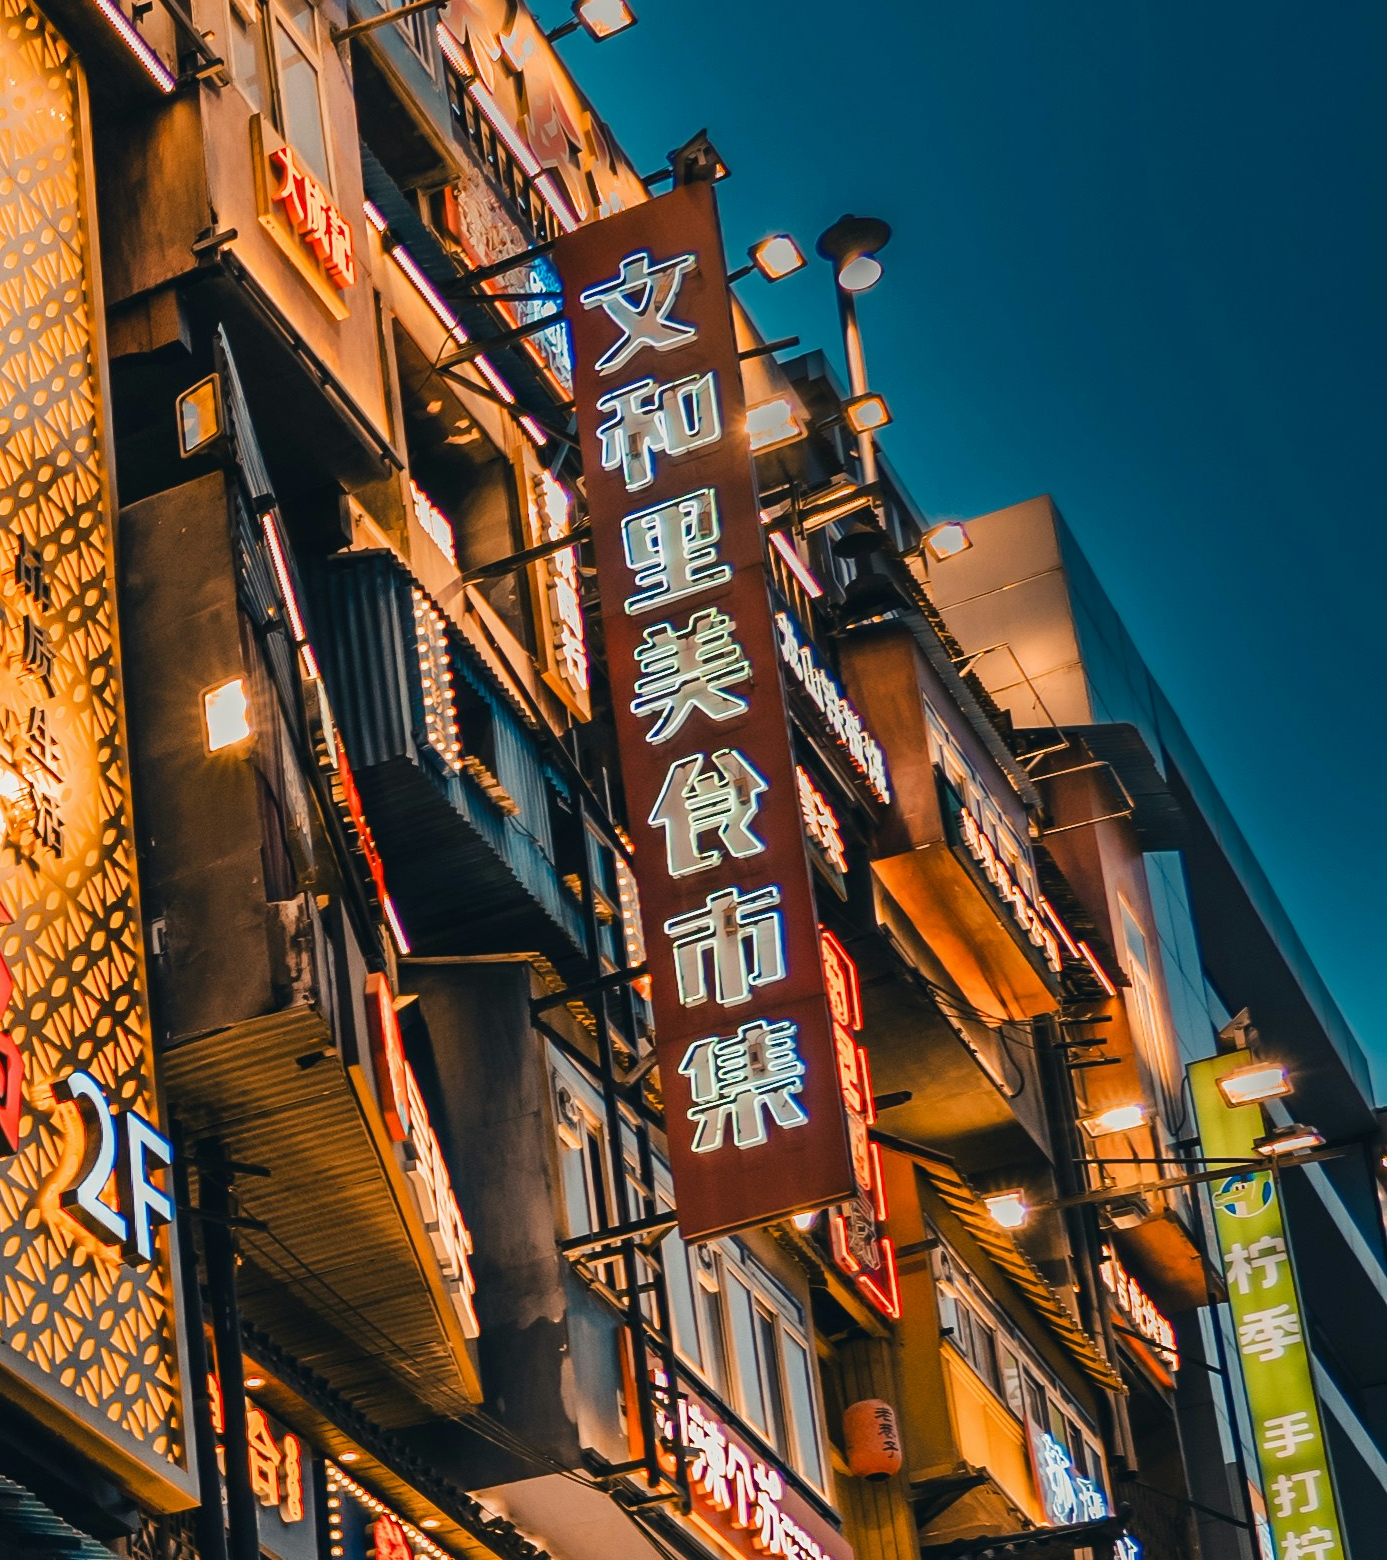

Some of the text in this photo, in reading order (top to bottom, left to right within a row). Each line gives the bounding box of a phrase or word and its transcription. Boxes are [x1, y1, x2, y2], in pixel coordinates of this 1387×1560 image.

[580, 250, 809, 1156] 文和里美食市集
[69, 1072, 176, 1262] 2F
[1224, 1236, 1302, 1362] 柠季
